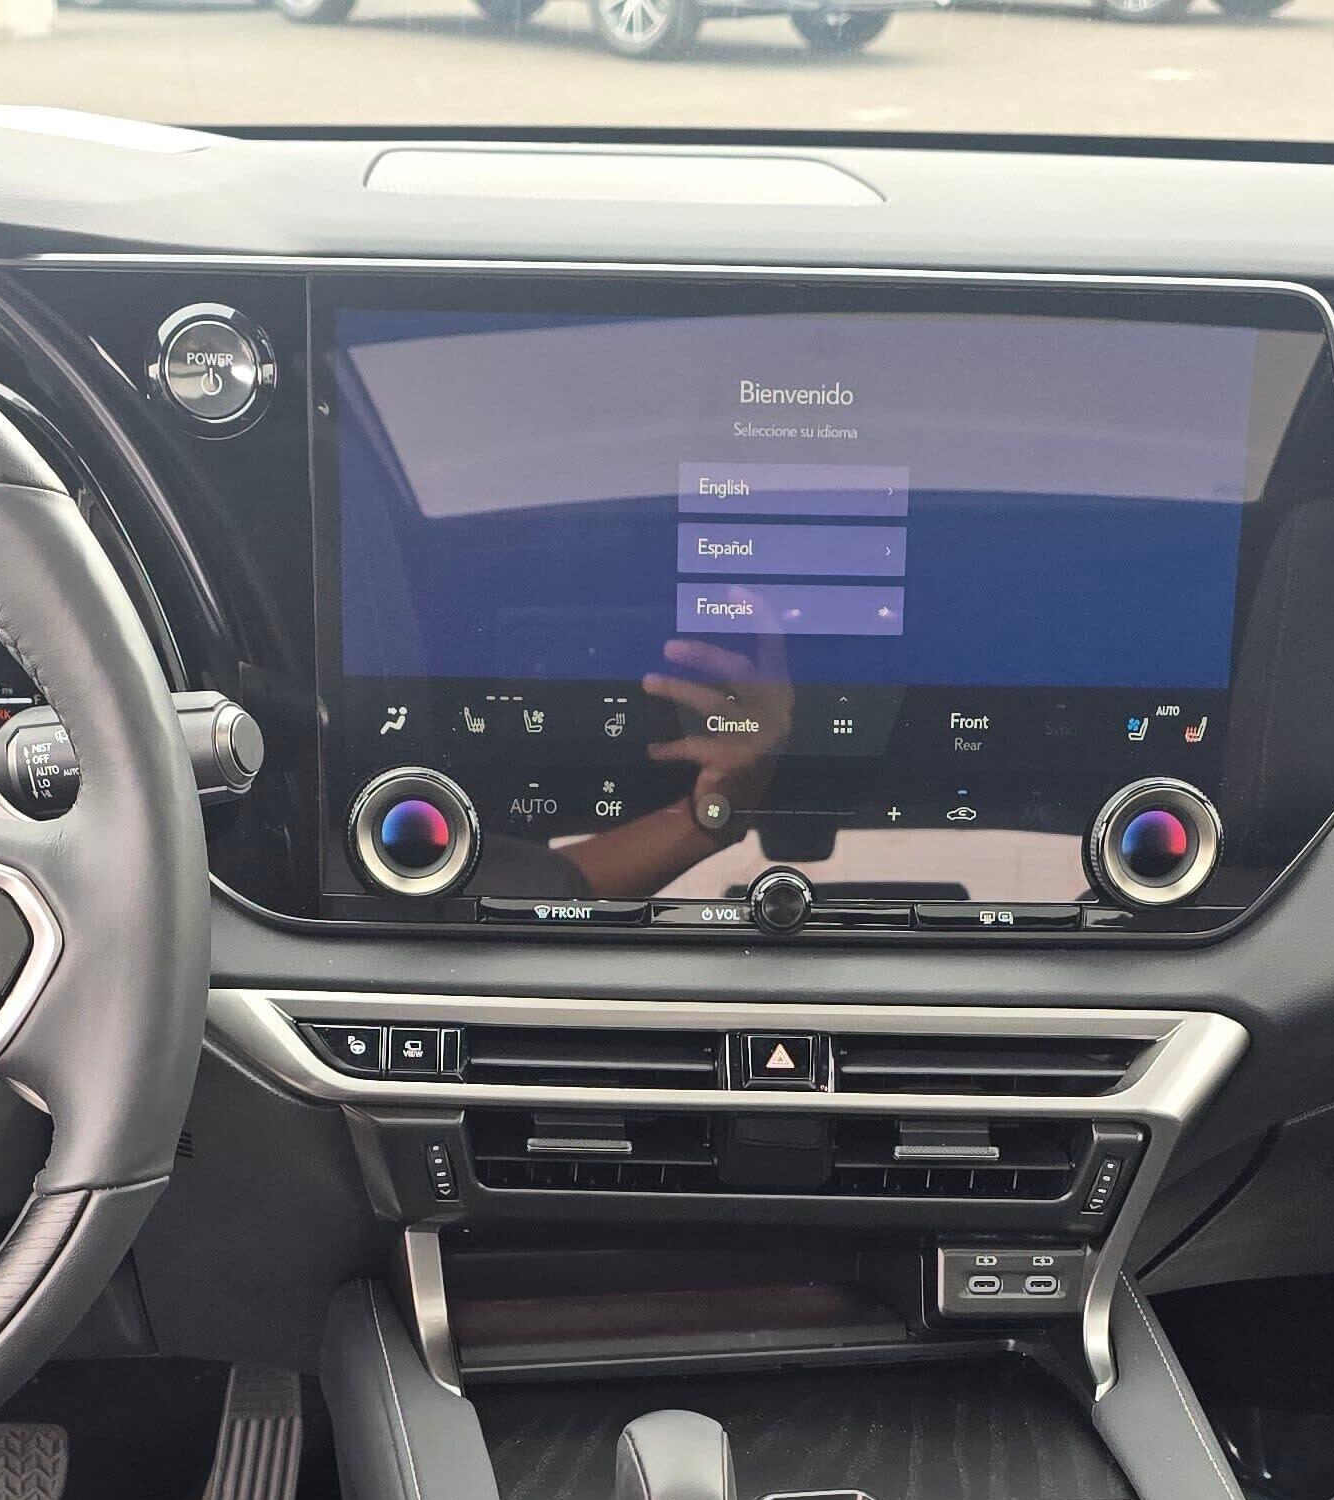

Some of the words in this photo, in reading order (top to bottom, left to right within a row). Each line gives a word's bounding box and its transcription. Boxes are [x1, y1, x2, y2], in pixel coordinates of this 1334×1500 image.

[186, 352, 234, 366] POWER
[739, 380, 854, 405] Bienvenido
[733, 422, 798, 438] Seleccione
[800, 426, 814, 438] su
[817, 424, 858, 439] idioma
[698, 477, 750, 499] English
[697, 537, 753, 561] Español
[696, 597, 754, 619] Français
[1155, 705, 1180, 716] AUTO
[706, 715, 760, 734] Climate
[949, 712, 989, 731] Front
[31, 742, 53, 754] MIST
[954, 737, 982, 752] Rear
[31, 753, 51, 765] OFF
[36, 764, 61, 777] AUTO
[37, 778, 52, 789] LO
[509, 798, 557, 815] AUTO
[595, 800, 622, 818] Off
[551, 906, 593, 920] FRONT
[715, 907, 741, 921] VOL
